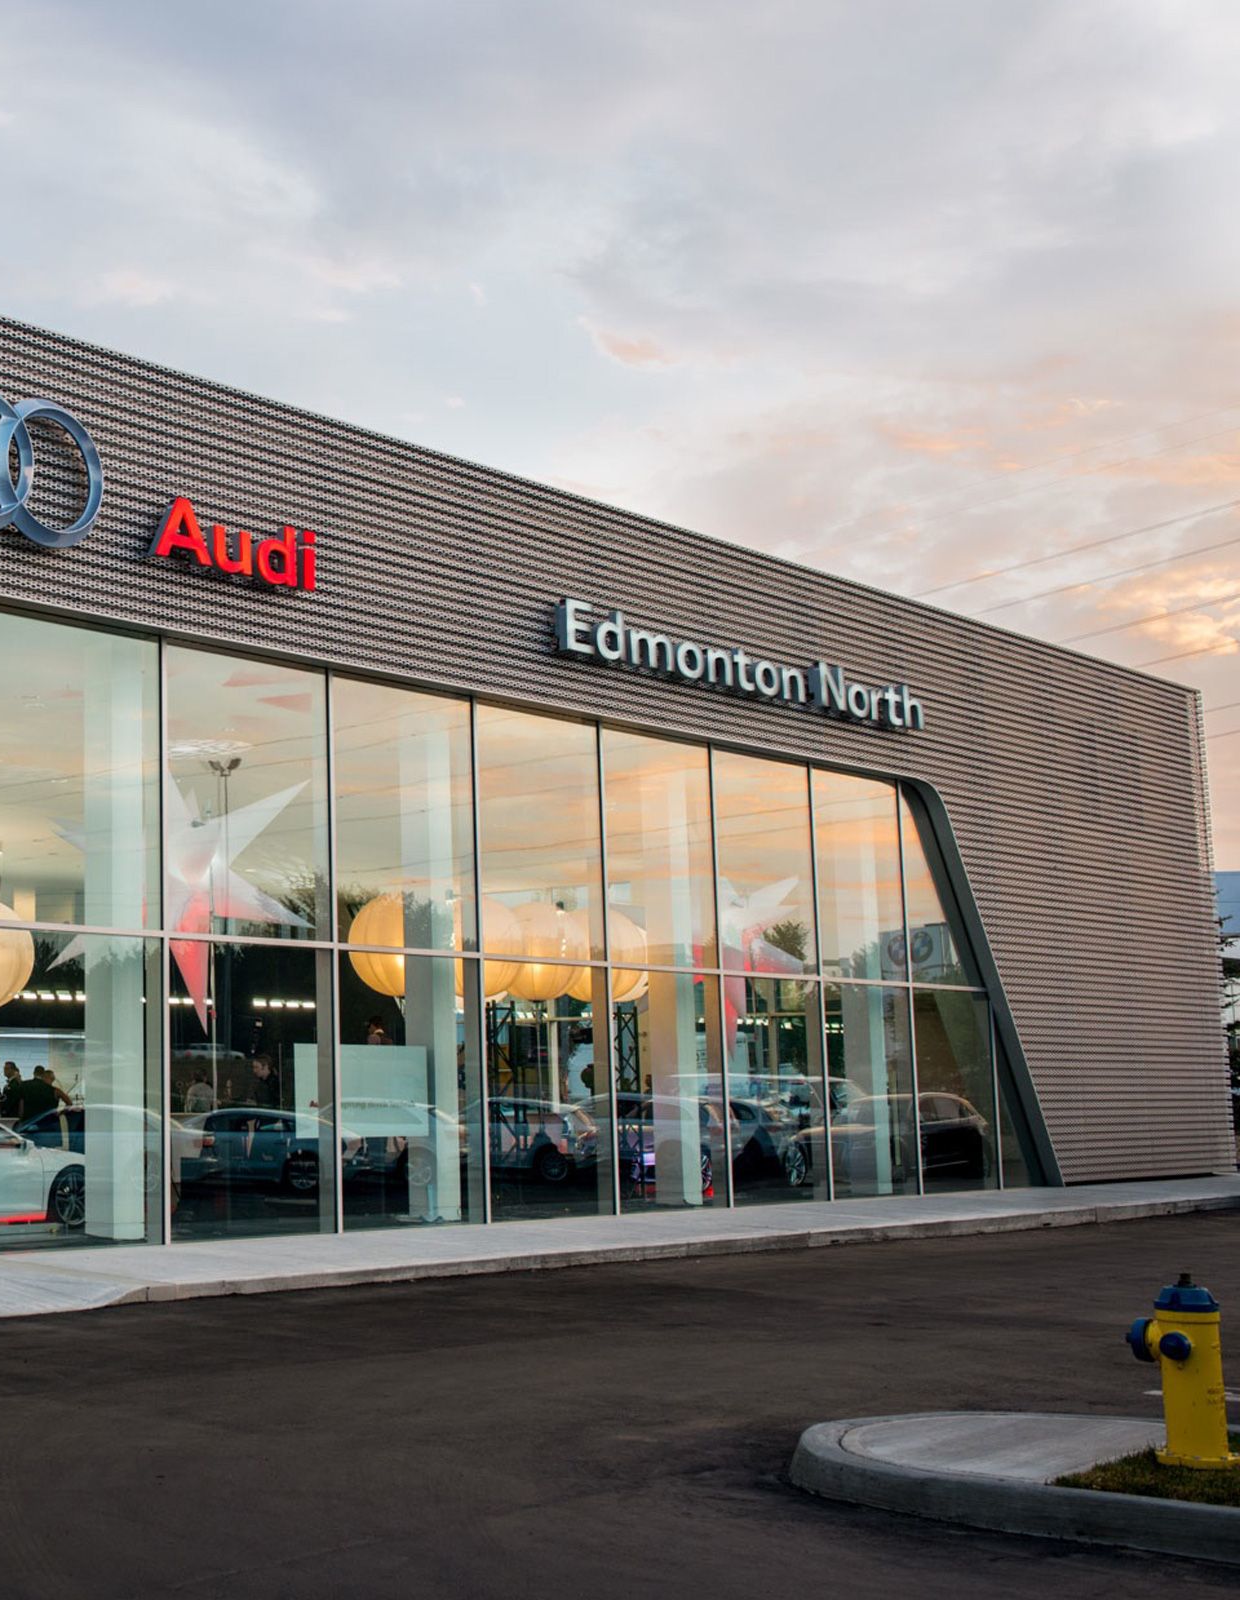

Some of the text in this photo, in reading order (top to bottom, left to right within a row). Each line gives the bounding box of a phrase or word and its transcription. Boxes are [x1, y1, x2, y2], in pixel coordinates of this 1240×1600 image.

[151, 496, 317, 592] Audi
[562, 598, 925, 730] Edmonton North
